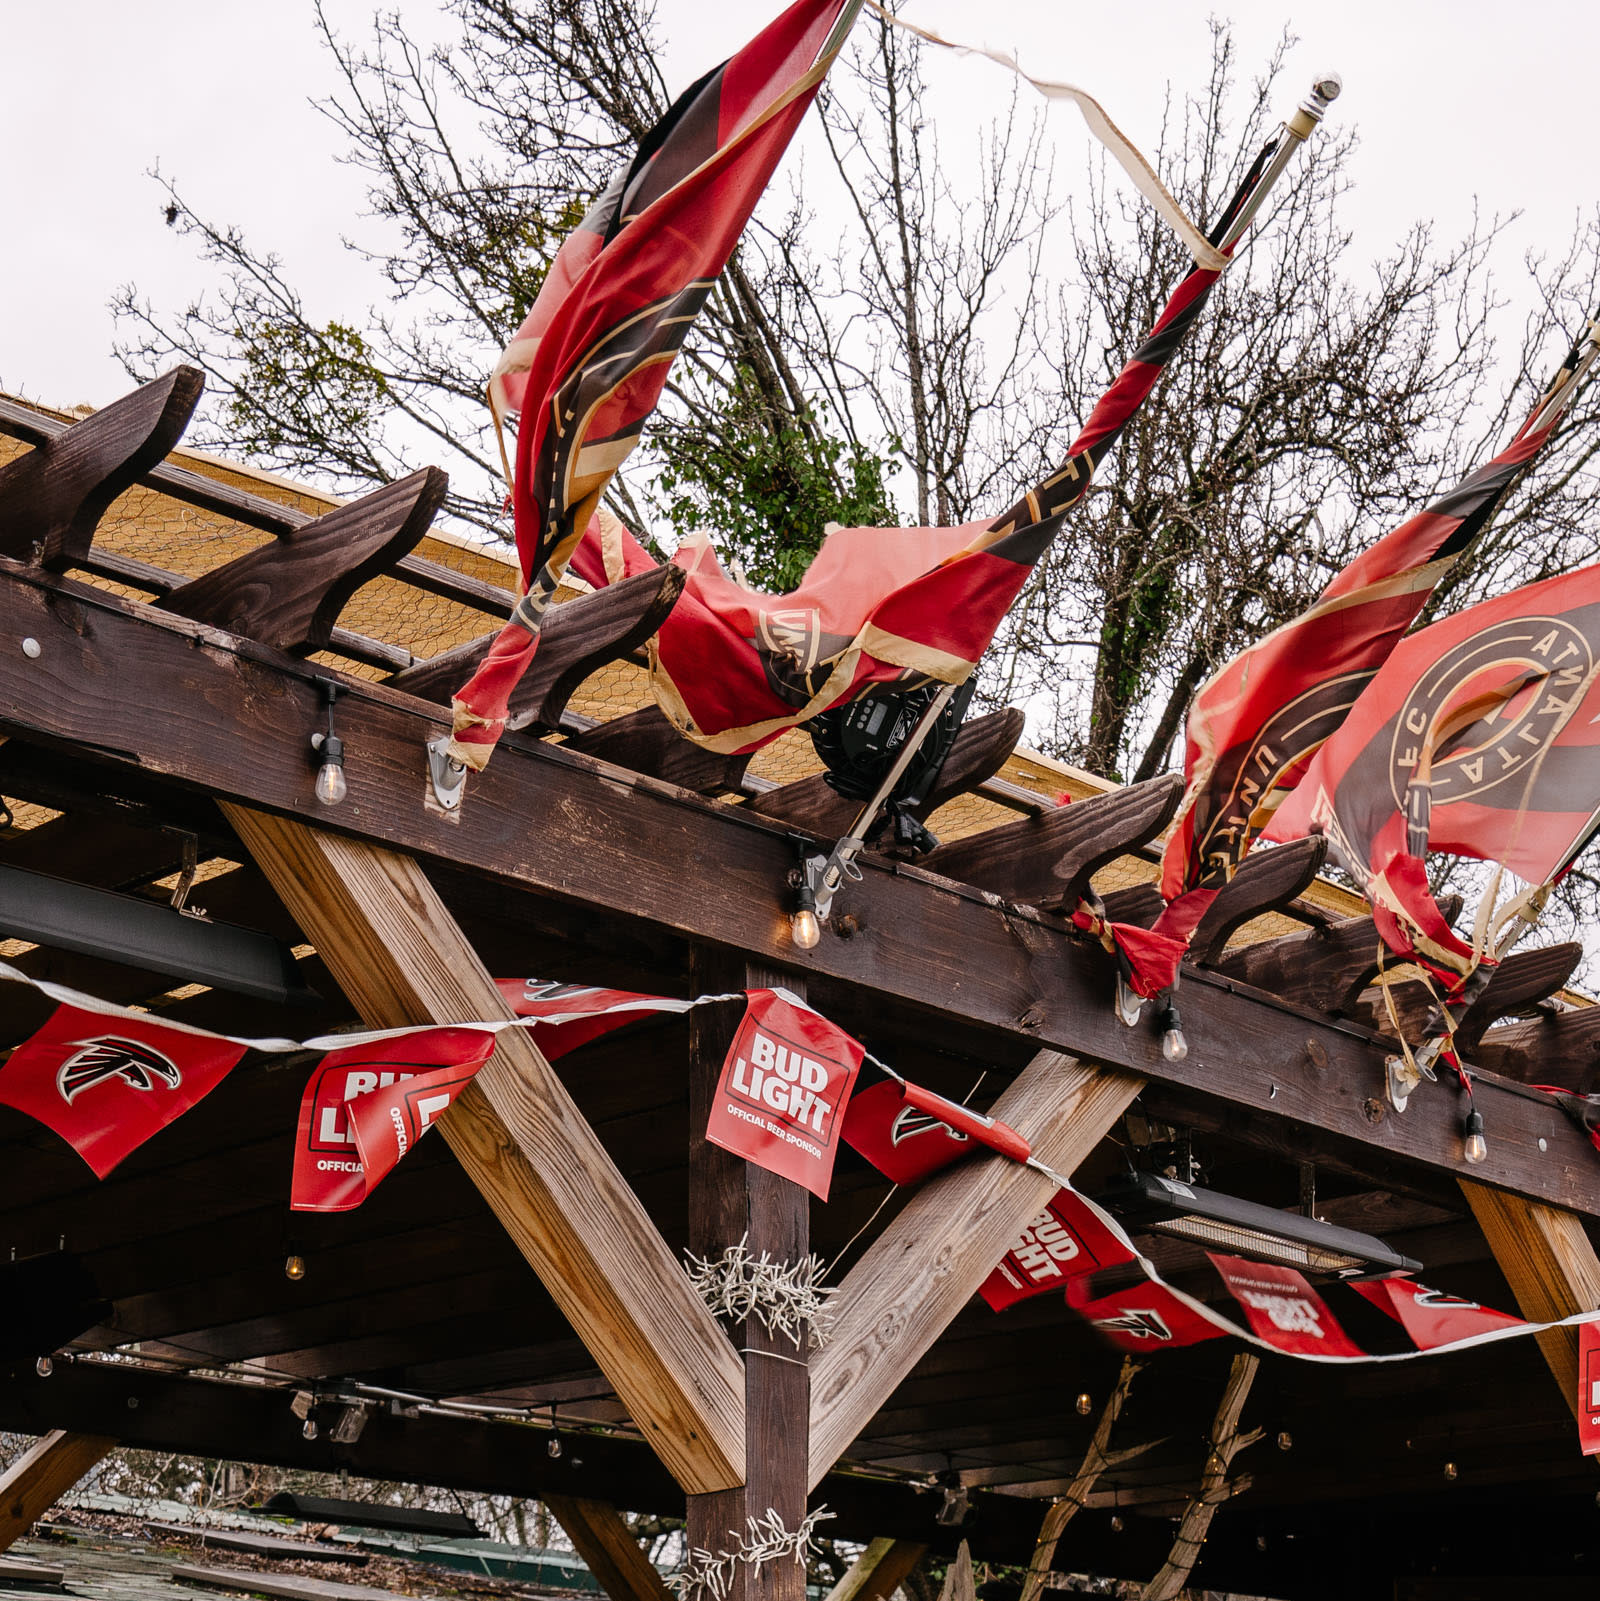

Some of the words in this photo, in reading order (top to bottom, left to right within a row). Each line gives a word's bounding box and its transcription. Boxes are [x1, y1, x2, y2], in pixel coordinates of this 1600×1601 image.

[750, 1032, 829, 1093] BUD
[731, 1057, 832, 1134] LIGHT
[727, 1103, 766, 1129] OFFICIAL
[766, 1121, 786, 1140] BEER
[785, 1132, 823, 1160] SPONSOR
[1008, 1228, 1063, 1283] GHT
